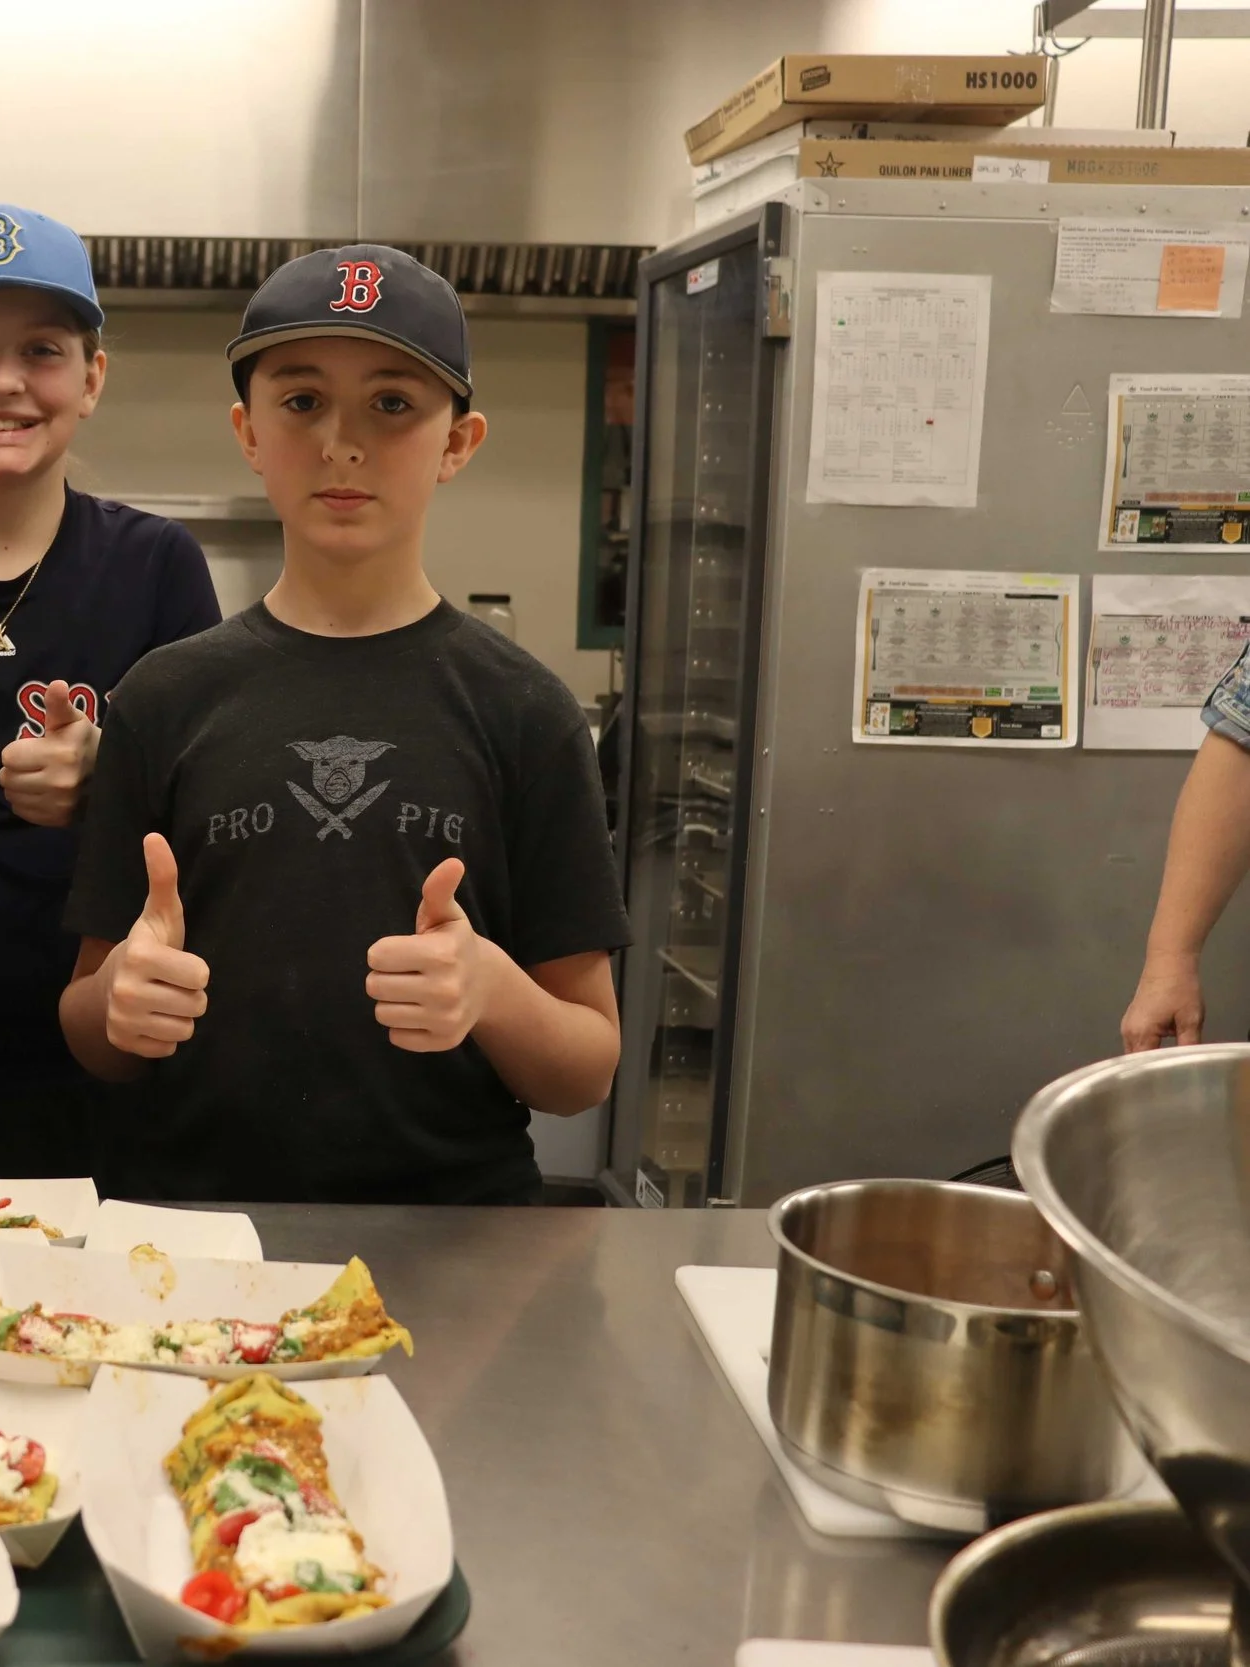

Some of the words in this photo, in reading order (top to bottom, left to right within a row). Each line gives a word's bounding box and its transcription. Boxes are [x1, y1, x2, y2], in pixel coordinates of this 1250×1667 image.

[966, 72, 1038, 89] HS1000
[879, 165, 916, 177] QUILON
[920, 166, 939, 177] PAN
[943, 166, 972, 178] LINER
[330, 261, 384, 313] B
[206, 802, 275, 845] PRO
[397, 802, 465, 844] PIG
